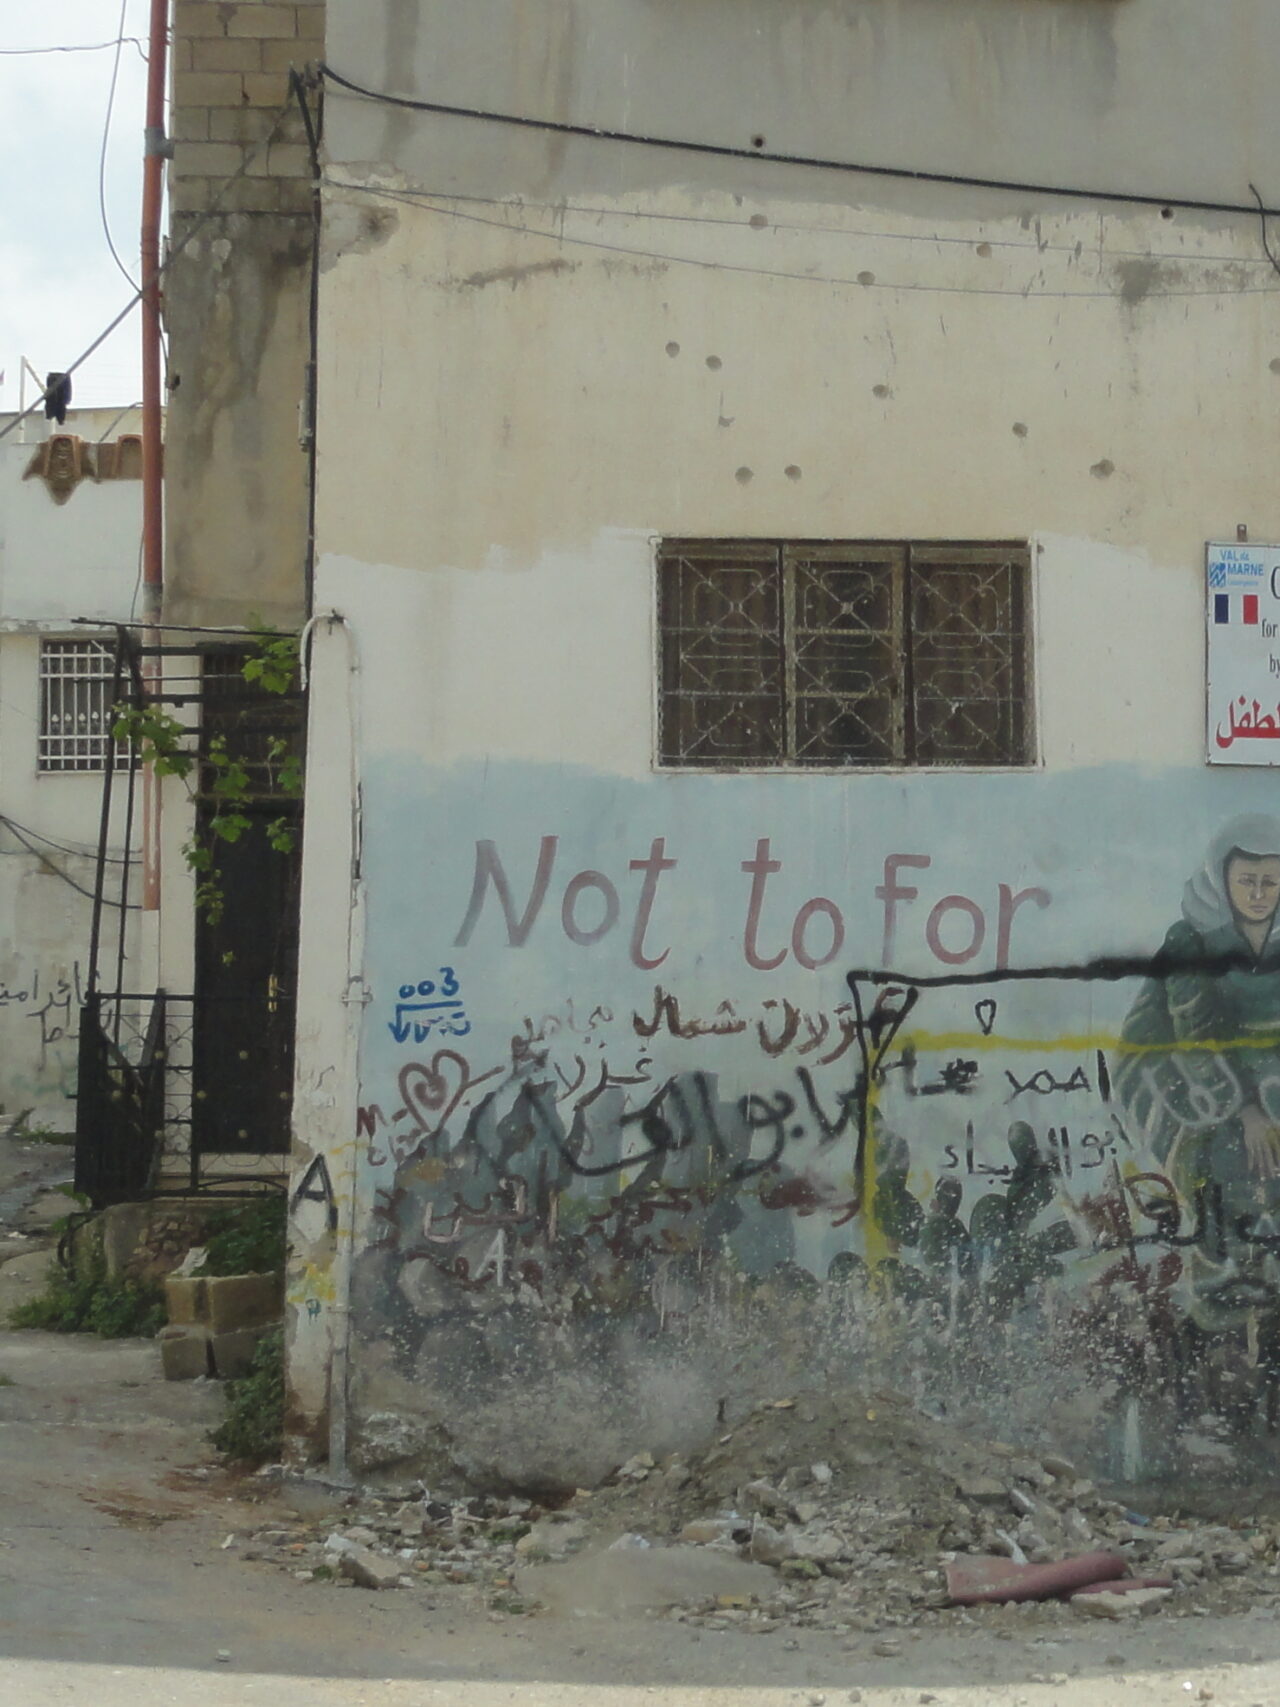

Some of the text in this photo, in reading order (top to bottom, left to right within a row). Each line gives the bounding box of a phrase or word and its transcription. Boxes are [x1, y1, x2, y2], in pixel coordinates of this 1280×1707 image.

[1227, 563, 1265, 576] MARNE
[1261, 618, 1276, 639] for
[1269, 653, 1280, 678] by
[452, 835, 678, 971] Not
[741, 837, 845, 971] to
[875, 854, 1051, 972] for
